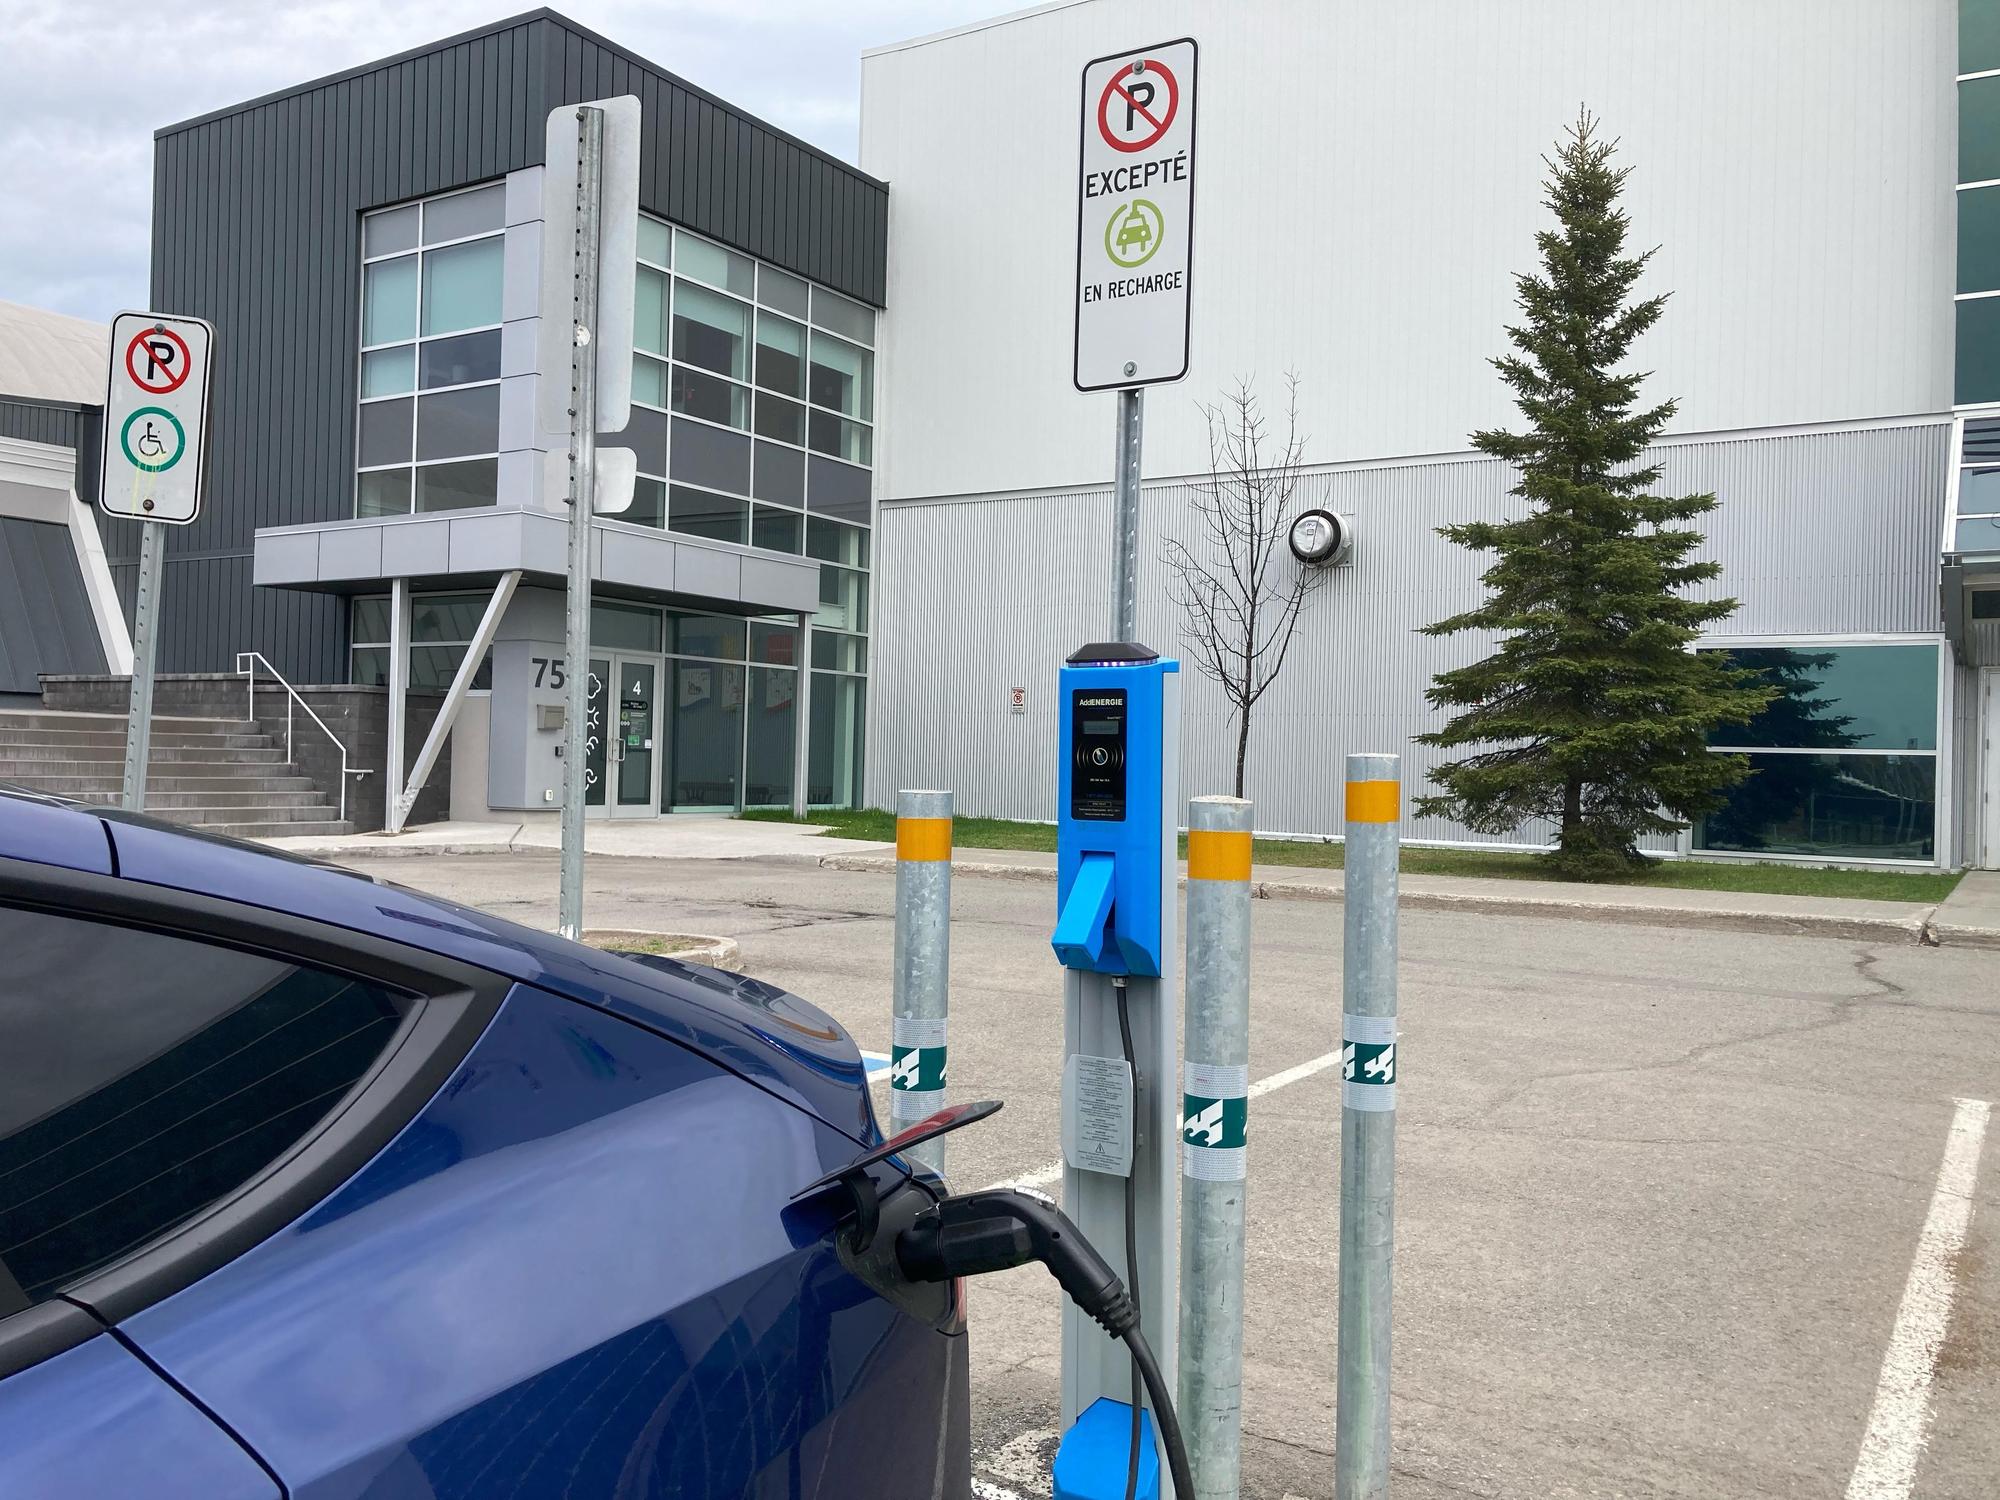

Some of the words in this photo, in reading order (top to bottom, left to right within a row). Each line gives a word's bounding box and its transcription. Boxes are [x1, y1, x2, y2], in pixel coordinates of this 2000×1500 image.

[1126, 81, 1156, 132] P
[1085, 149, 1188, 199] EXCEPTÉ
[1084, 283, 1102, 304] EN
[1108, 270, 1183, 300] RECHARGE
[147, 340, 175, 380] P
[531, 657, 565, 690] 75
[632, 680, 642, 696] 4
[1079, 698, 1123, 706] AddENERGIE
